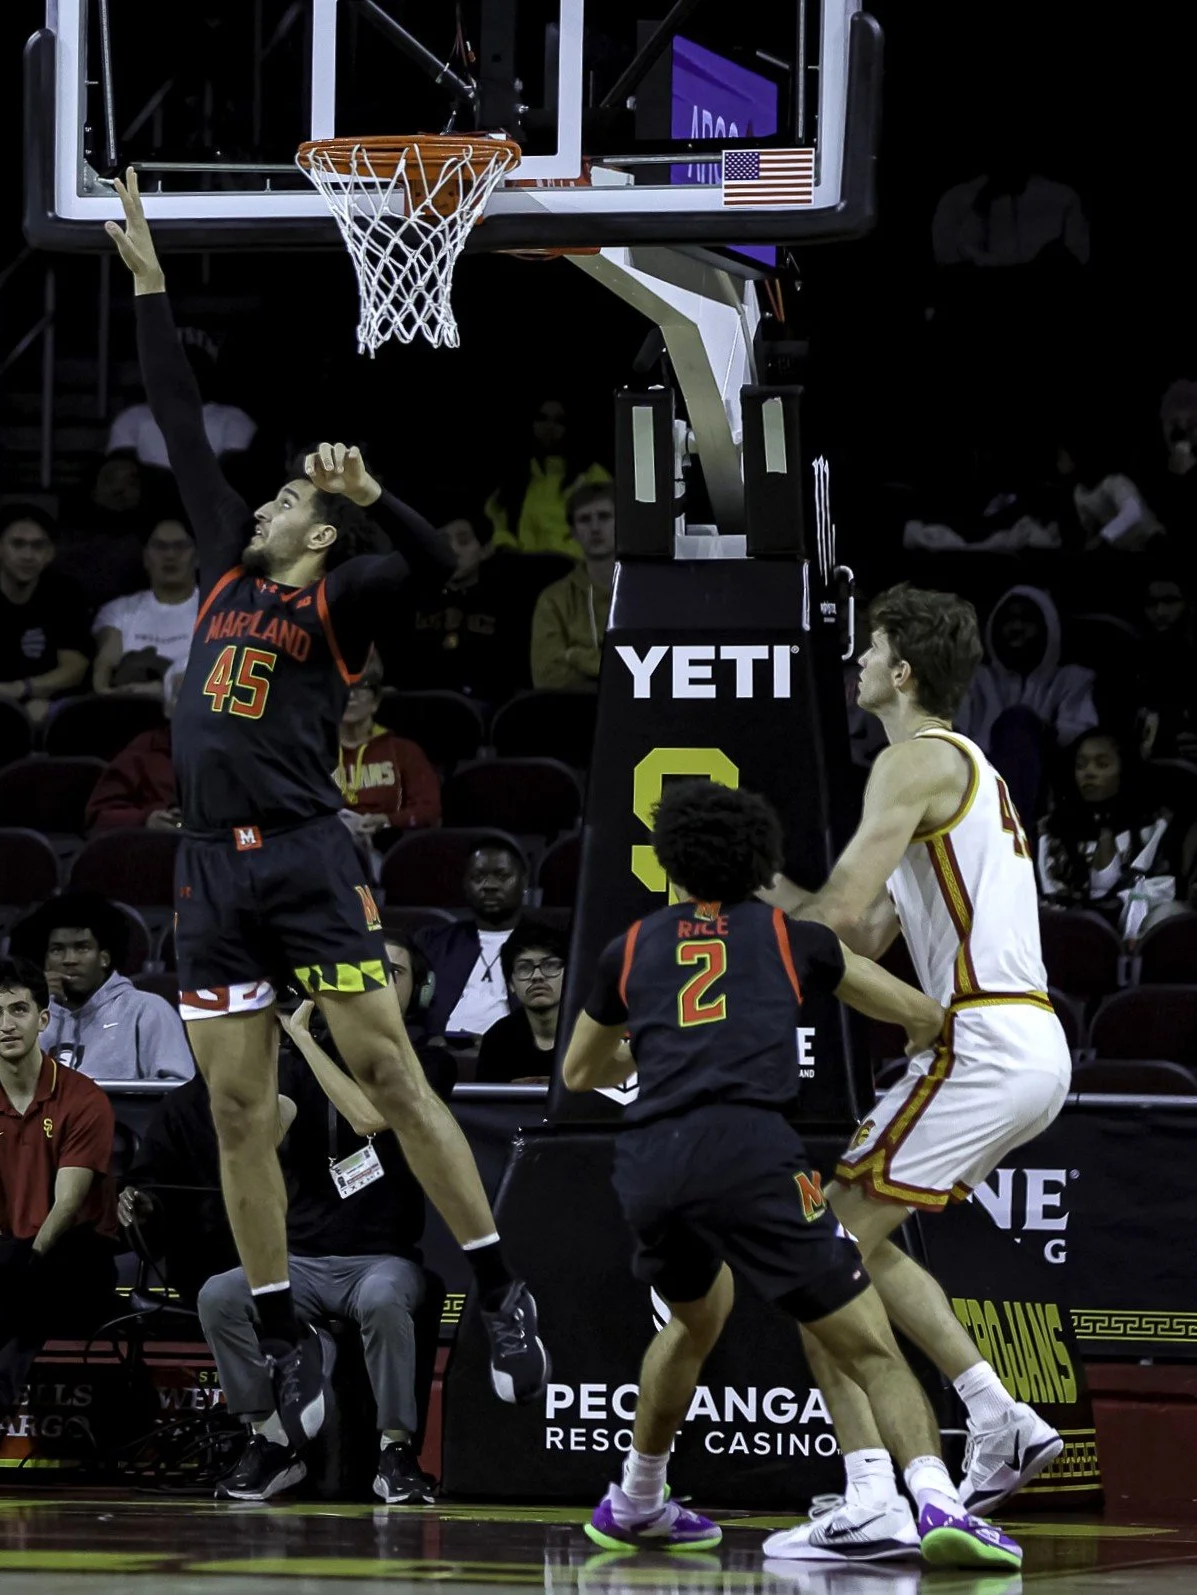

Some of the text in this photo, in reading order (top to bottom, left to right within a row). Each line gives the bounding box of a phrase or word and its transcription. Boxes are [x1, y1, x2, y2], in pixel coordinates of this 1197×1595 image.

[203, 645, 278, 719] 45
[614, 645, 791, 699] YETI
[238, 828, 257, 846] M
[676, 938, 727, 1027] 2
[545, 1383, 835, 1425] PECANGA
[545, 1426, 837, 1457] RESOT CASINO
